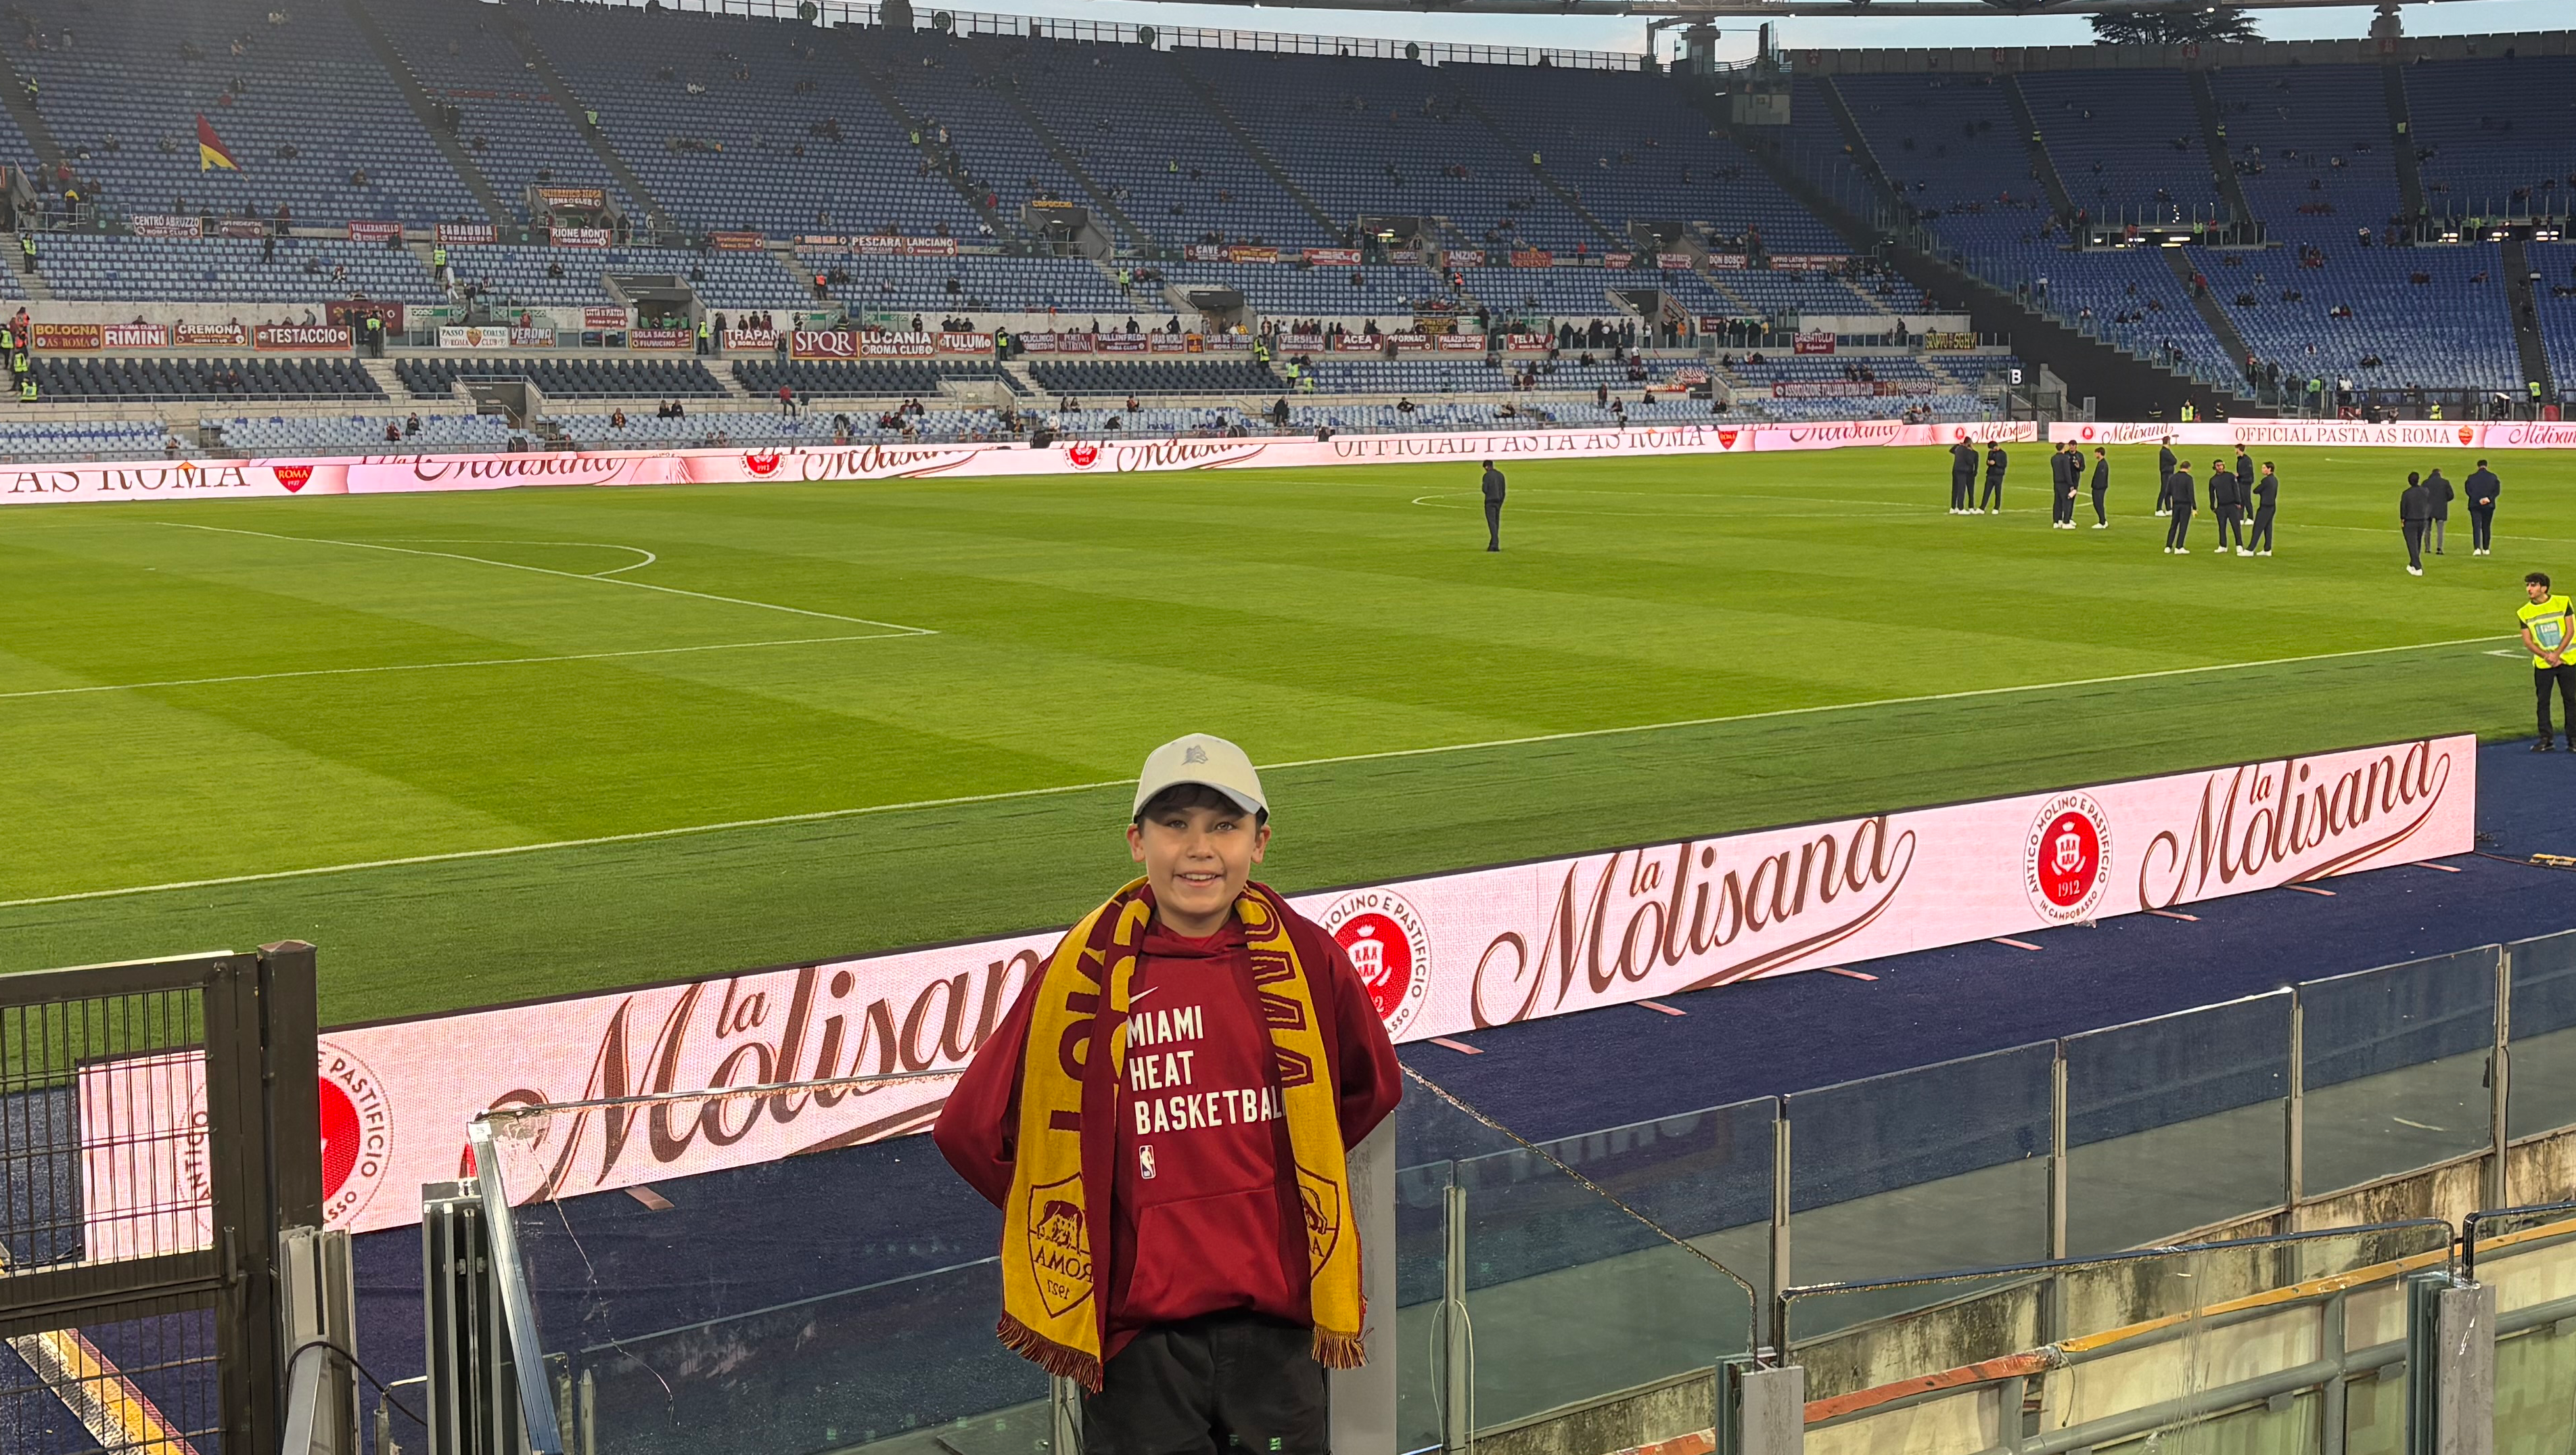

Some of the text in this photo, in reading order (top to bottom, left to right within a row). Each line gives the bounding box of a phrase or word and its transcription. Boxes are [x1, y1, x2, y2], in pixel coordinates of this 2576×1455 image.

[166, 216, 199, 228] ABRUZZO
[440, 225, 492, 235] SABAUDIA
[552, 228, 608, 238] RIONE MONTI
[852, 237, 901, 248] PESCARA
[906, 238, 953, 247] LANCIANO
[1196, 246, 1218, 254] CAVE
[1449, 251, 1476, 260] ANZIO
[1709, 255, 1745, 264] DON BOSCO
[36, 326, 98, 336] BOLOGNA
[178, 325, 242, 334] CREMONA
[268, 329, 337, 343] TESTACCIO
[441, 329, 464, 337] PASSO
[511, 328, 551, 340] VERONA
[46, 338, 91, 348] AS ROMA
[105, 330, 165, 345] RIMINI
[450, 338, 498, 346] ROMA CLUB
[796, 331, 854, 356] SPQR
[861, 331, 932, 344] LUCANIA
[944, 335, 984, 348] TULUM
[1207, 335, 1222, 343] CAVA
[1281, 335, 1323, 344] VERSILIA
[1343, 336, 1373, 344] ACEA
[1513, 335, 1527, 344] TEL
[871, 345, 927, 354] ROMA CLUB
[2012, 369, 2021, 384] B
[2235, 426, 2451, 443] OFFICIAL PASTA AS ROMA
[1334, 430, 1705, 458] OFFICIAL PASTA AS ROMA
[8, 466, 250, 493] AS ROMA
[279, 469, 308, 480] ROMA
[2250, 763, 2274, 805] la
[2140, 739, 2450, 910] Molisana
[2027, 796, 2109, 893] ANTICO MOLINO E PASTIFICIO
[1630, 848, 1664, 898] la
[2058, 880, 2080, 897] 1912
[2040, 891, 2097, 921] IN CAMPOBASSO
[1470, 814, 1916, 1030] Molisana
[1382, 897, 1392, 911] E
[1394, 903, 1426, 998] PASTIFICIO
[716, 977, 771, 1040] la
[1126, 1005, 1203, 1048] MIAMI
[470, 948, 1045, 1207] Molisan
[1129, 1050, 1194, 1092] HEAT
[329, 1058, 384, 1178] PASTIFICIO
